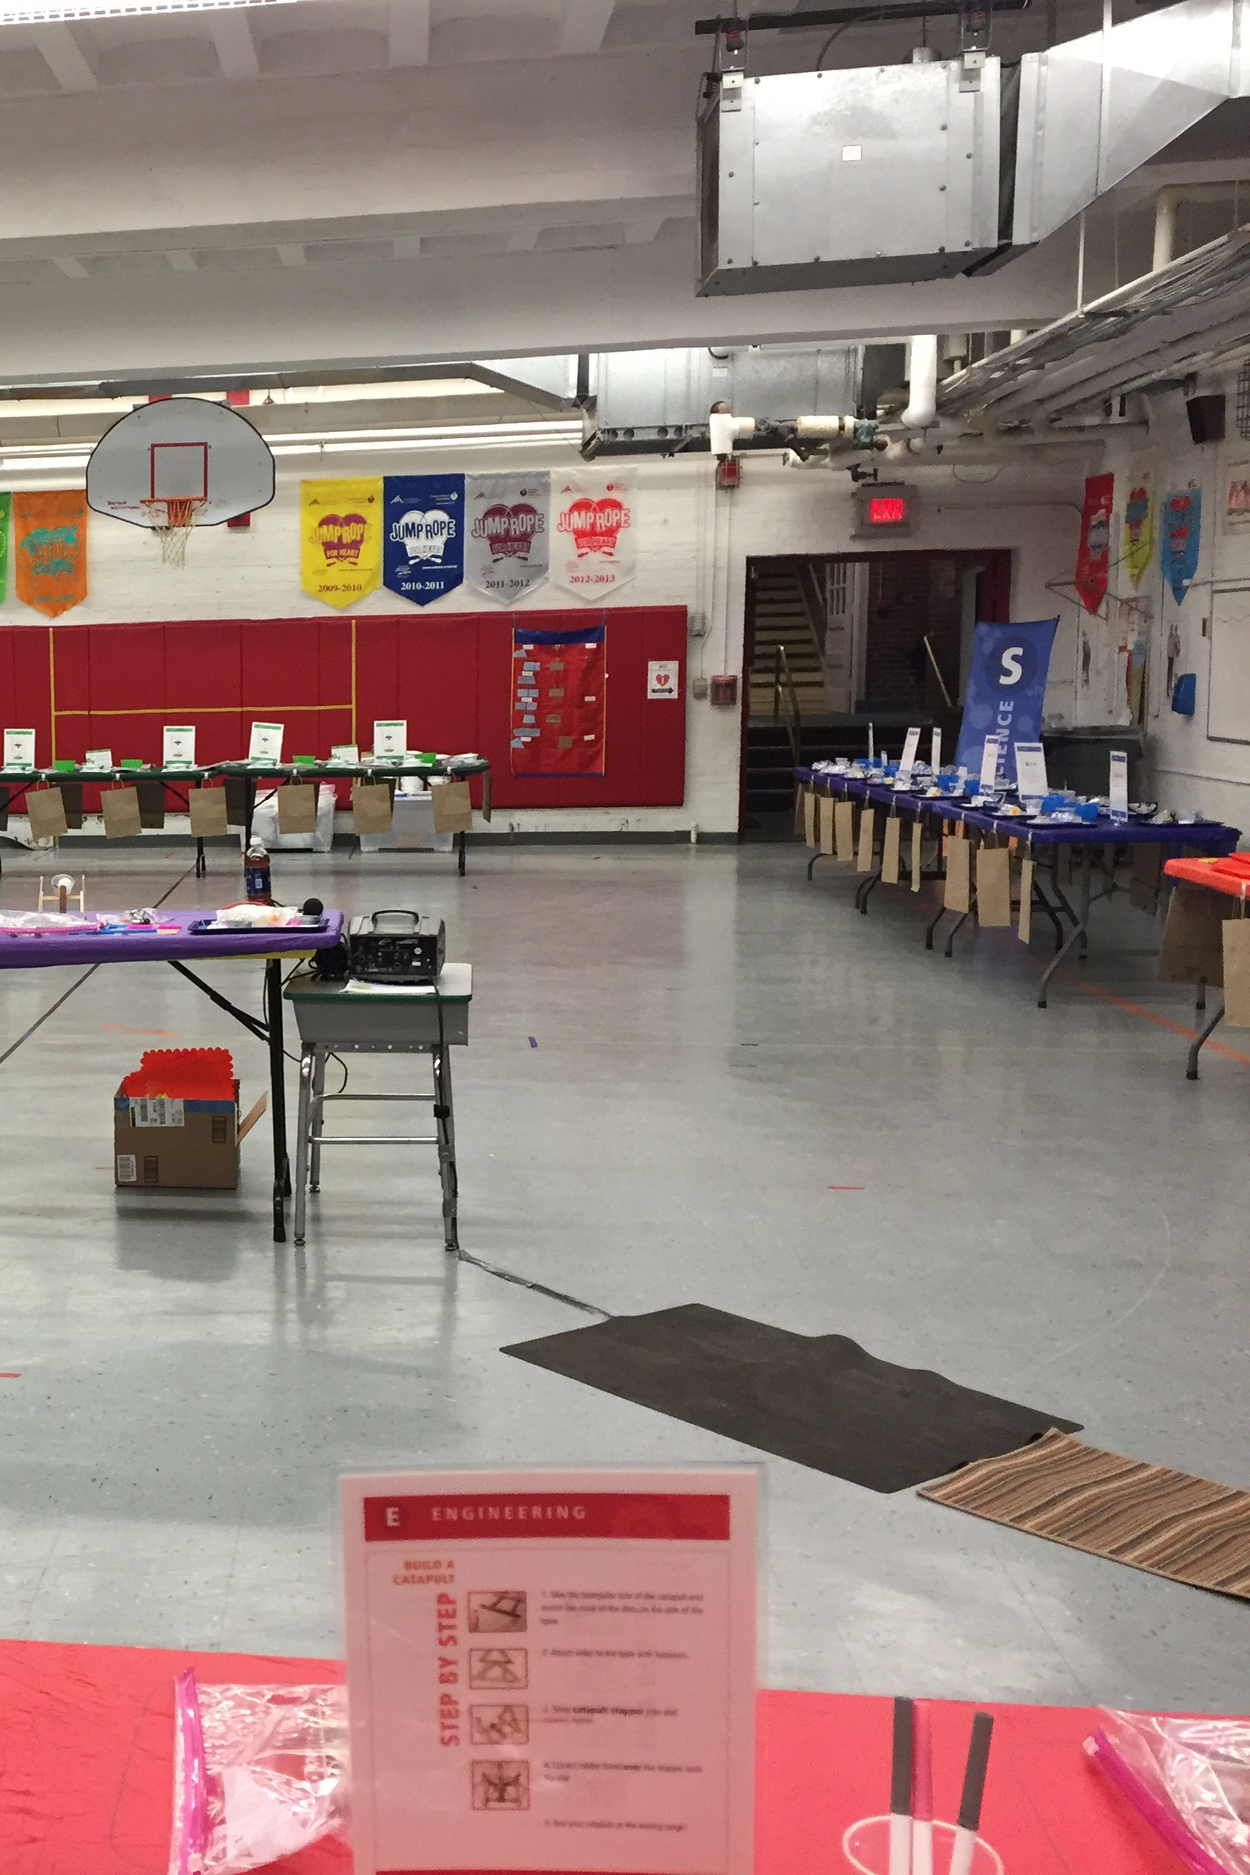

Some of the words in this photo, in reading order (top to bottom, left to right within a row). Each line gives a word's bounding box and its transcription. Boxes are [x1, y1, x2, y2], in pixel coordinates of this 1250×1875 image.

[390, 521, 423, 541] JUMP
[425, 518, 456, 539] ROPE
[471, 517, 509, 538] JUMP
[510, 513, 545, 537] ROPE
[557, 511, 594, 532] JUMP
[595, 508, 630, 531] ROPE
[310, 525, 340, 543] JUMP
[342, 523, 372, 543] ROPE
[339, 549, 359, 557] HEART
[318, 584, 362, 593] 2009-2010
[401, 581, 444, 590] 2010-2011
[485, 579, 530, 589] 2011-2012
[569, 574, 615, 584] 2012-2013
[999, 646, 1024, 685] S
[385, 1507, 401, 1527] E
[431, 1505, 587, 1521] ENGINEERING
[404, 1560, 442, 1570] BUILD
[447, 1560, 454, 1569] A
[393, 1574, 454, 1585] CATAPULT
[436, 1592, 458, 1647] STEP
[438, 1656, 458, 1684] BY
[439, 1693, 460, 1747] STEP
